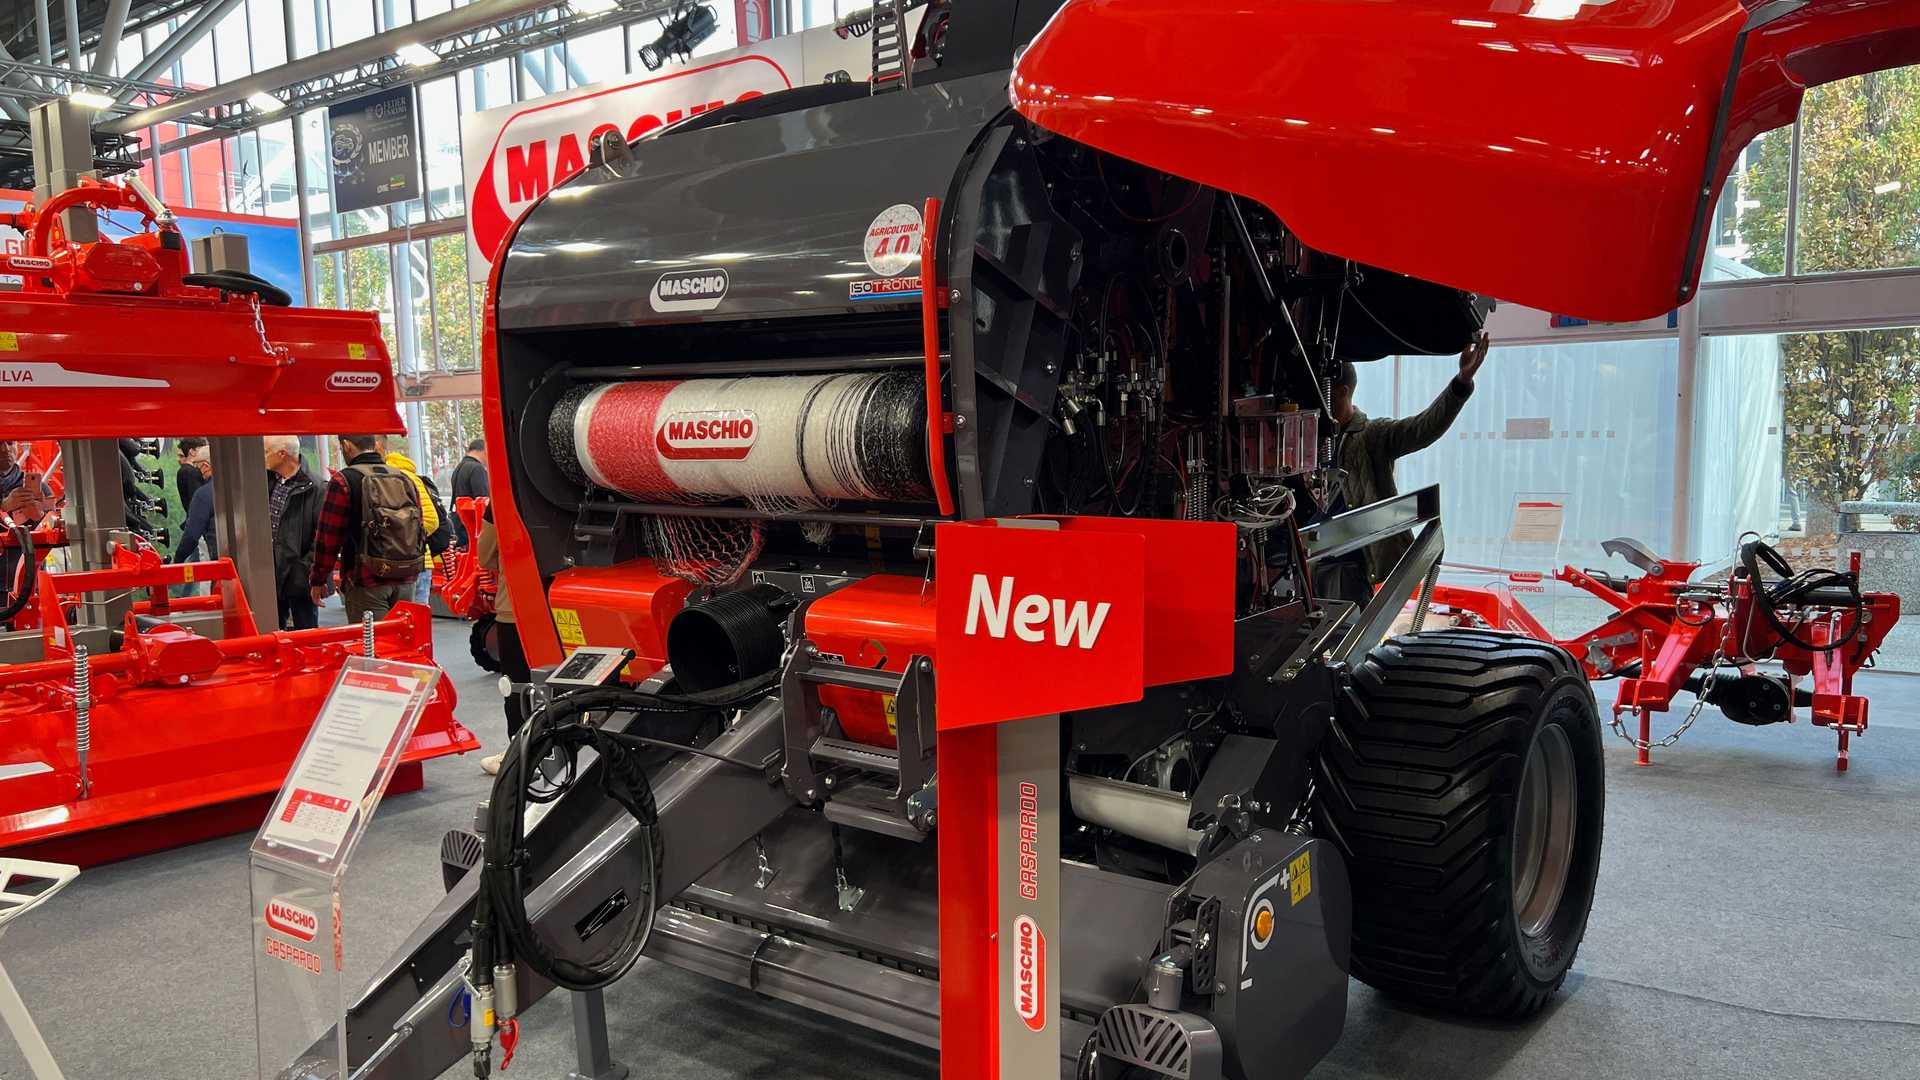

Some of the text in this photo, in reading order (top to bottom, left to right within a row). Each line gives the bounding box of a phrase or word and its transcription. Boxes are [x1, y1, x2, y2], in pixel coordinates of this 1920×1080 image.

[368, 134, 410, 165] MEMBER
[867, 223, 919, 238] AGRICOLTURA
[660, 275, 725, 297] MASCHIO
[851, 279, 922, 293] ISOTRONIC
[333, 375, 378, 384] MASCHIO
[668, 418, 754, 440] MASCHIO
[964, 573, 1112, 650] New
[1019, 782, 1038, 900] GASPARDO
[271, 903, 316, 930] MASCHIO
[265, 937, 321, 976] GASPARDO
[1020, 921, 1033, 1014] MASCHIO
